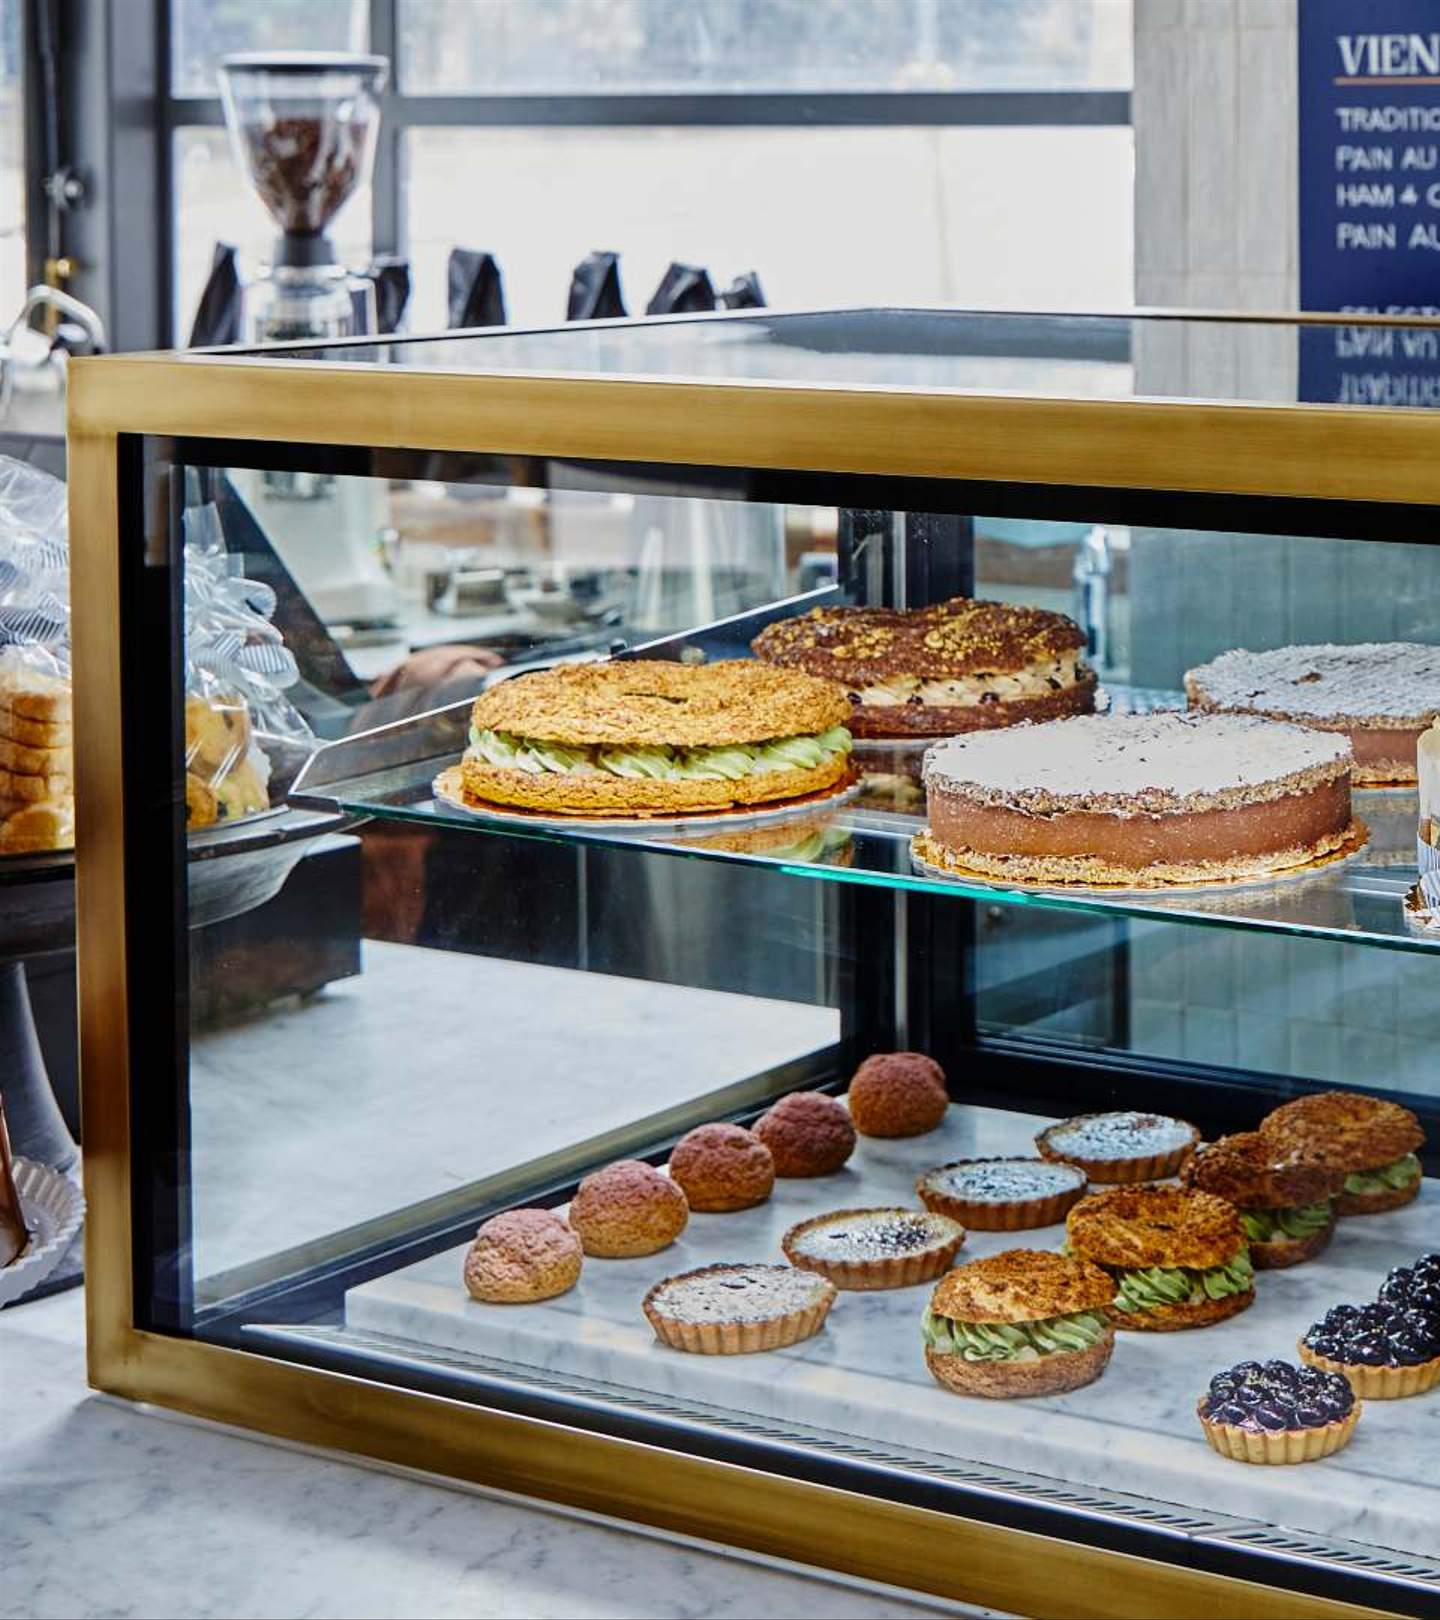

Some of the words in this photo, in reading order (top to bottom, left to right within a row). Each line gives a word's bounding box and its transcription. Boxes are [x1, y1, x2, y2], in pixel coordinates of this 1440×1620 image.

[1335, 146, 1393, 171] PAIN
[1401, 146, 1438, 170] AU
[1336, 183, 1395, 208] HAM
[1336, 223, 1397, 249] PAIN
